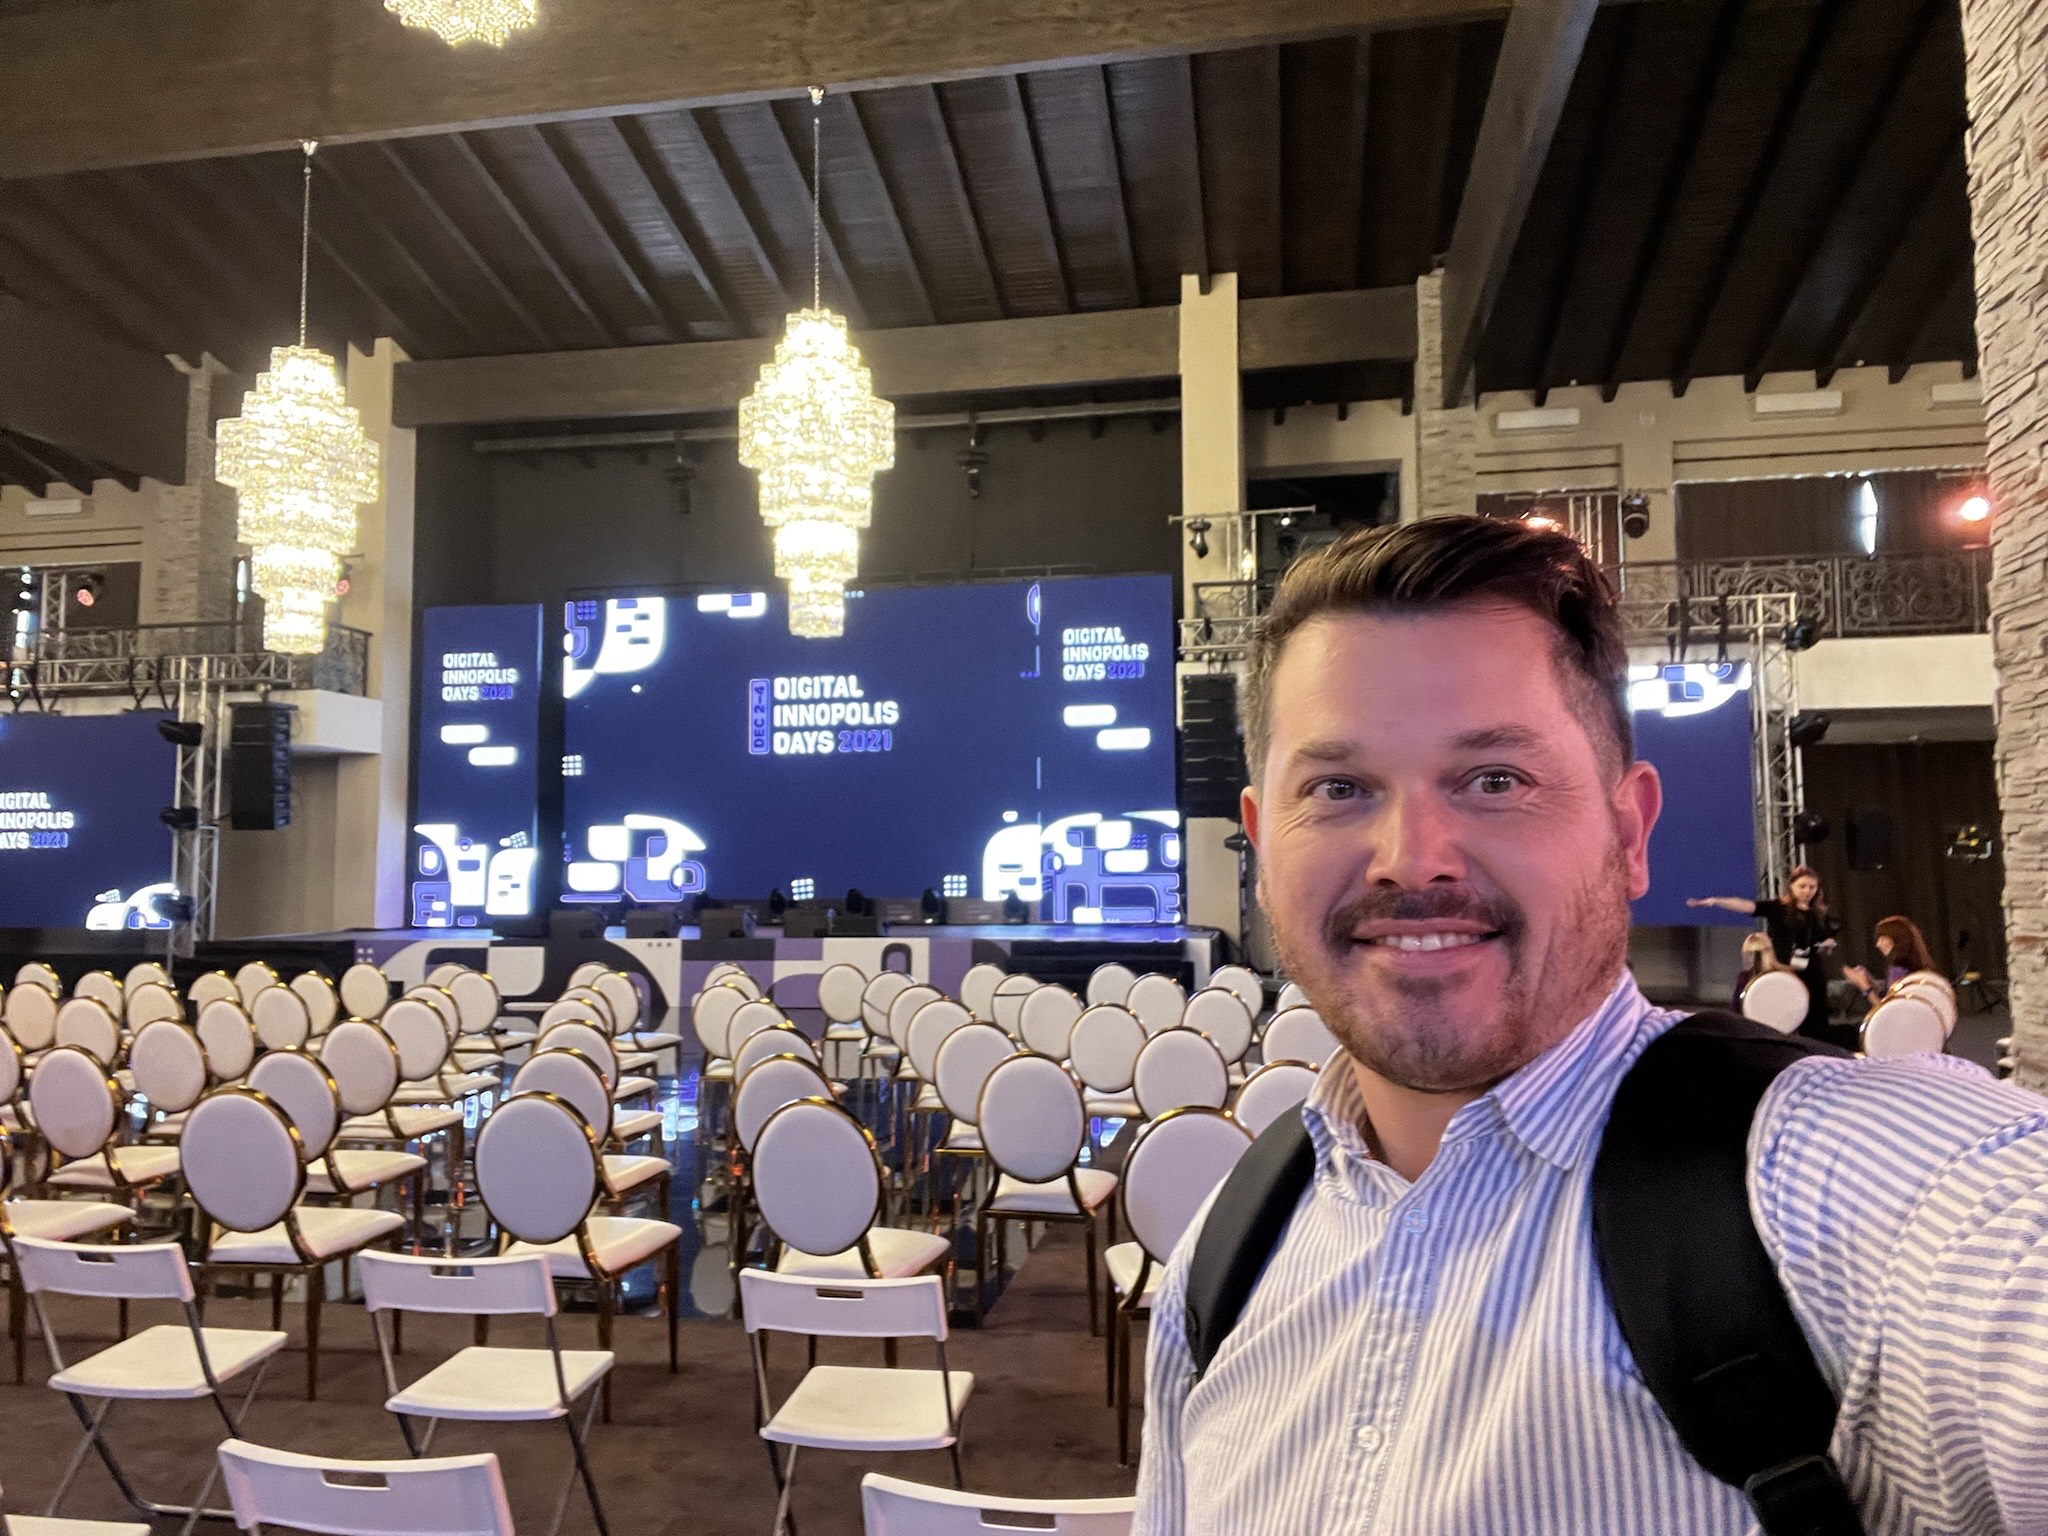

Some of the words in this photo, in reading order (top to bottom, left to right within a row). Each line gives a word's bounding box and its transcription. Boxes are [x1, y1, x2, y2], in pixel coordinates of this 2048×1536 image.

[1063, 627, 1125, 645] DIGITAL
[443, 652, 498, 669] DIGITAL
[1063, 643, 1149, 662] INNOPOLIS
[442, 668, 518, 685] INNOPOLIS
[1063, 663, 1106, 681] DAYS
[1107, 662, 1145, 679] 2021
[442, 686, 479, 701] DAYS
[480, 685, 513, 700] 2021
[773, 675, 864, 700] DIGITAL
[773, 701, 899, 727] INNOPOLIS
[754, 715, 765, 748] DEC
[773, 730, 835, 754] DAYS
[838, 729, 893, 752] 2021
[0, 792, 51, 810] IGITAL
[0, 811, 74, 829] NOPOLIS
[0, 831, 30, 850] AYS
[30, 831, 68, 849] 2021
